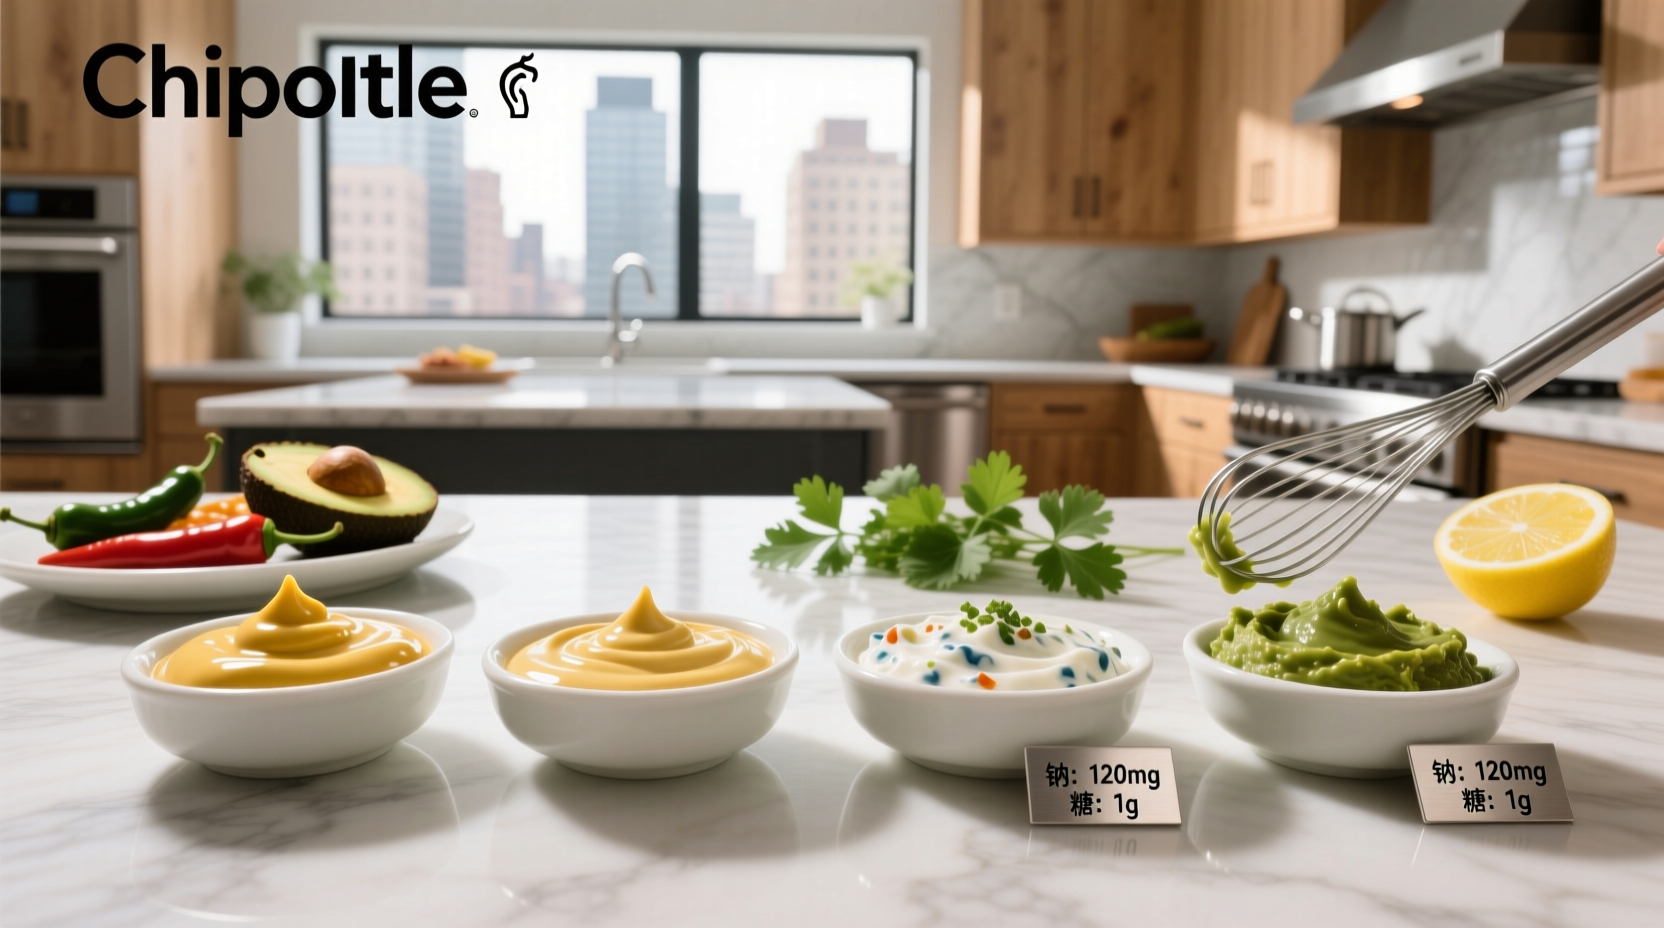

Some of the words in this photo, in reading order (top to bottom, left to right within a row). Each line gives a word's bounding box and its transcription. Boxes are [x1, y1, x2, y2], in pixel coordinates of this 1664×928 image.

[1089, 763, 1161, 790] 120mg
[1474, 760, 1547, 787] 120mg
[1113, 793, 1139, 820] 1g
[1504, 788, 1532, 816] 1g
